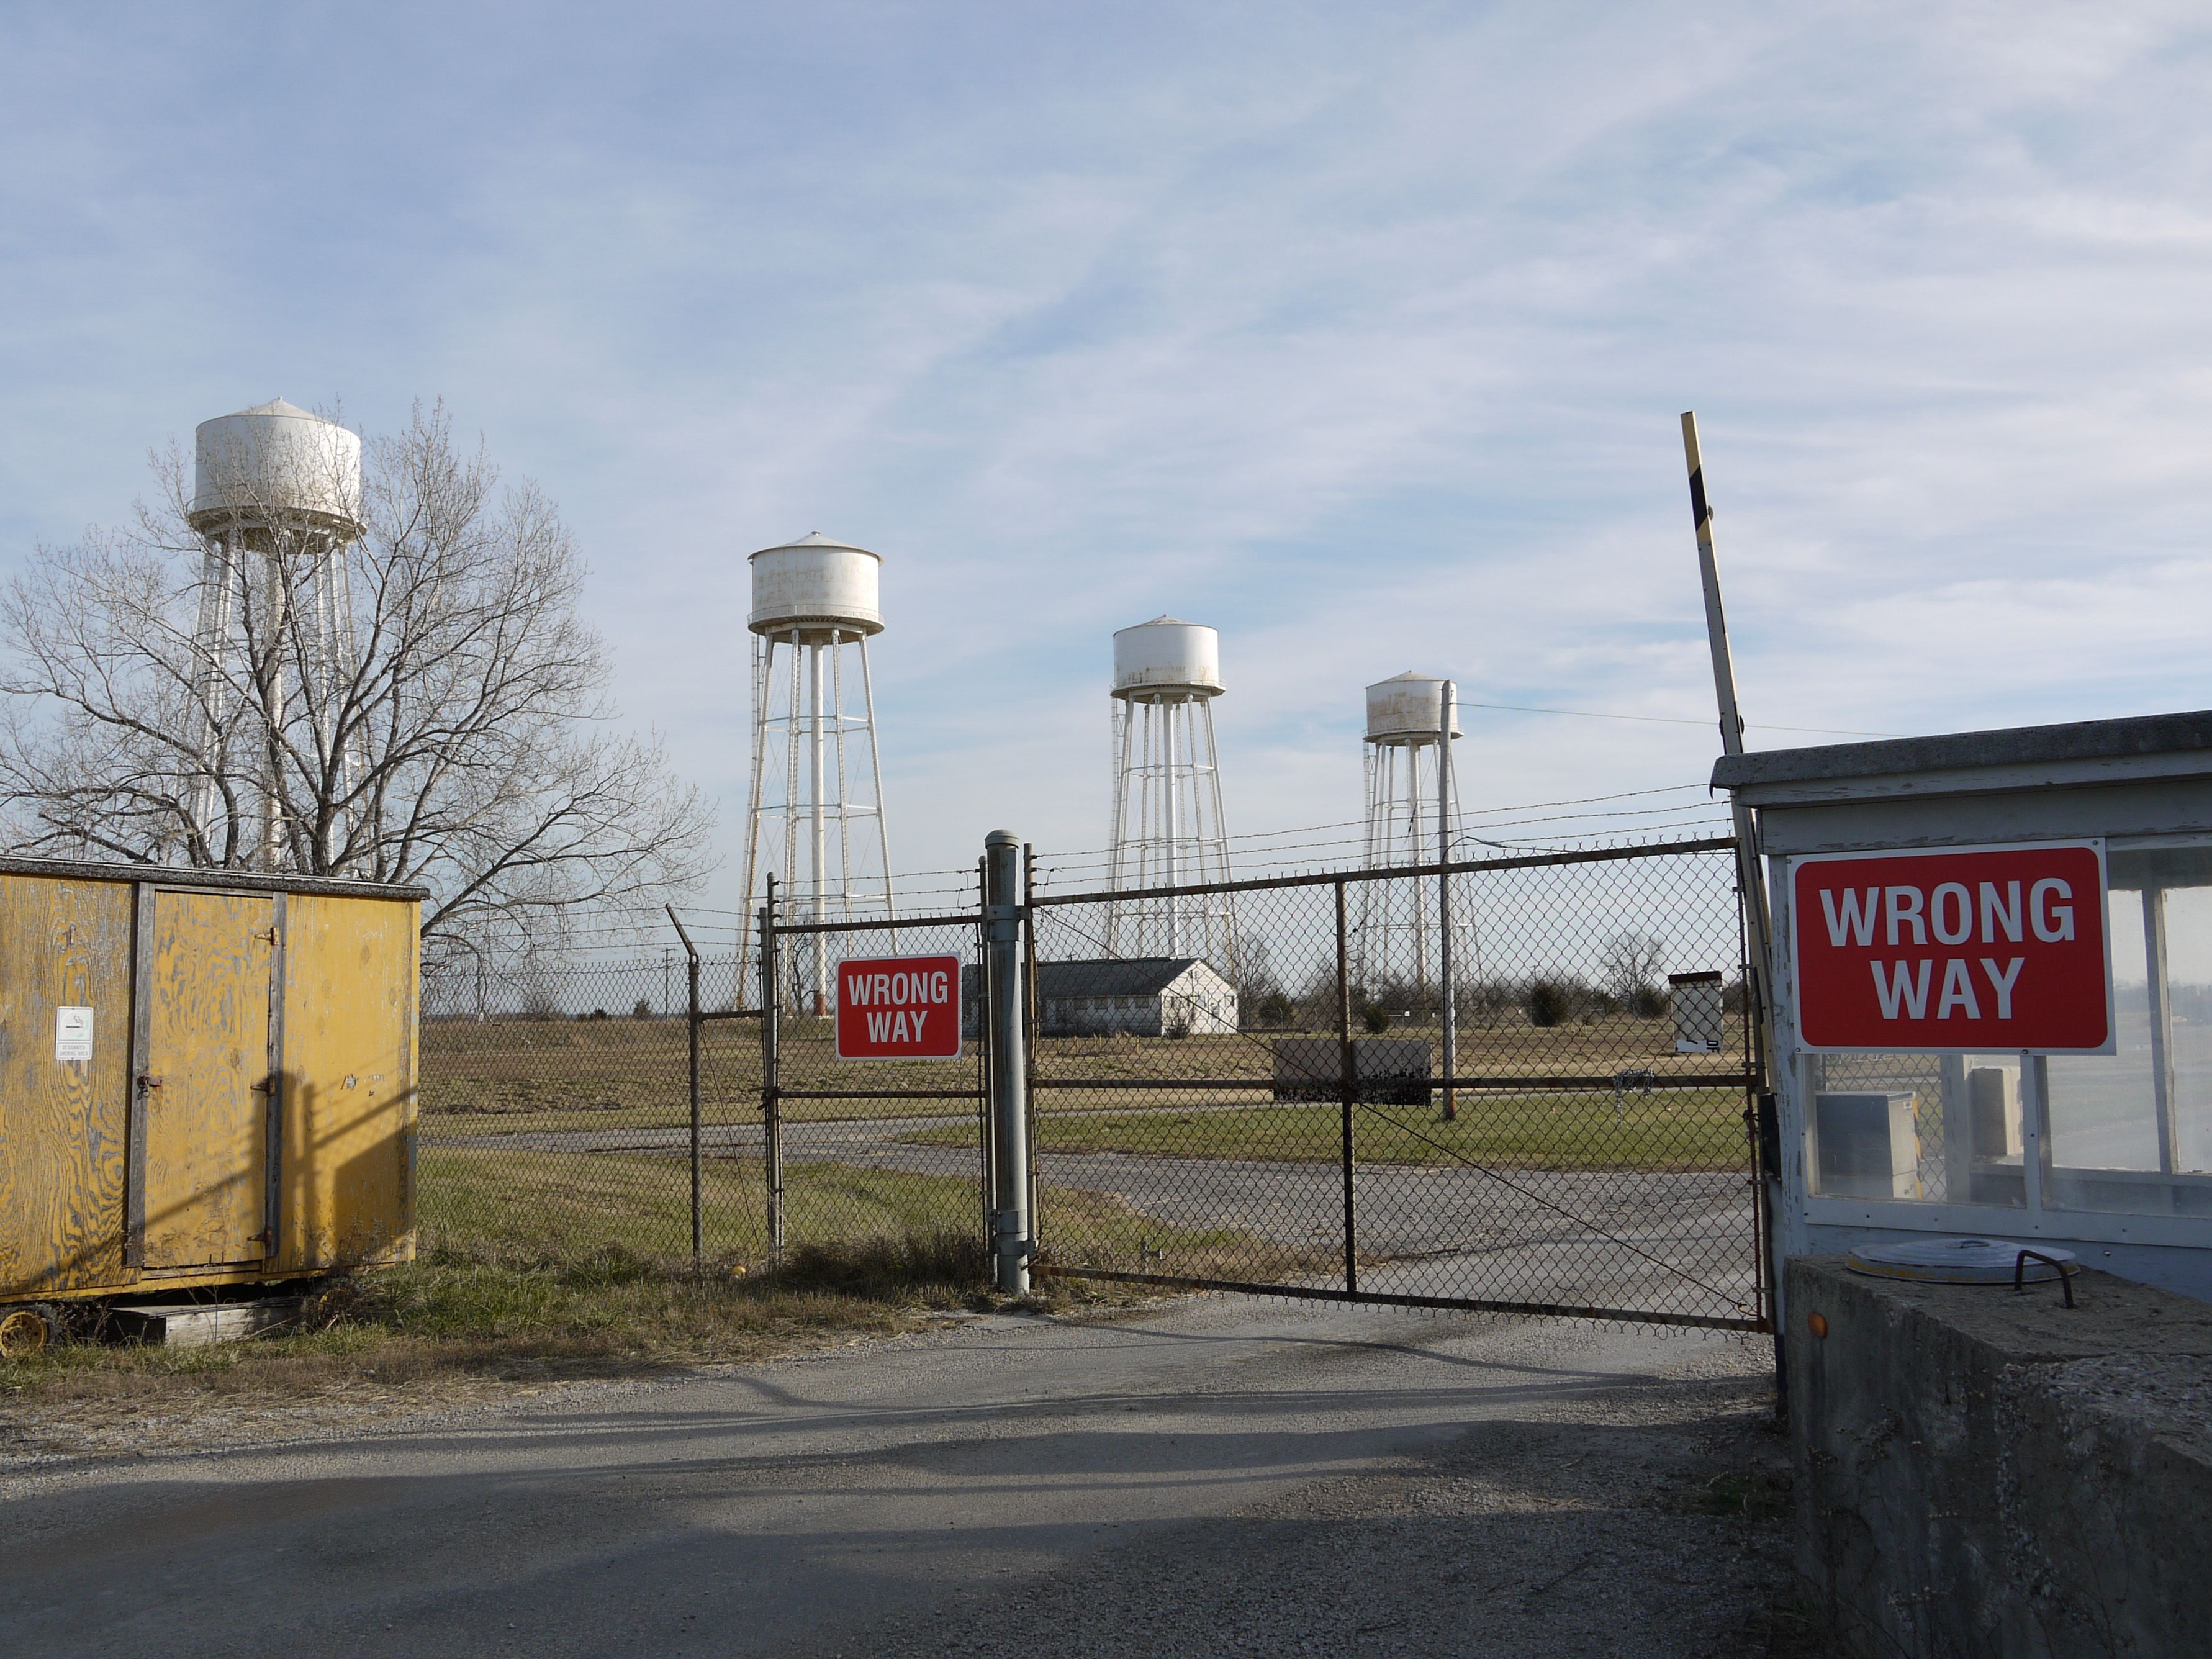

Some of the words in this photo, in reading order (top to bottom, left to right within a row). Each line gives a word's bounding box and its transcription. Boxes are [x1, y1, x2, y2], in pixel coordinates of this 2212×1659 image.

[1819, 877, 2075, 947] WRONG
[847, 971, 948, 1006] WRONG
[1869, 957, 2025, 1019] WAY
[867, 1010, 928, 1043] WAY
